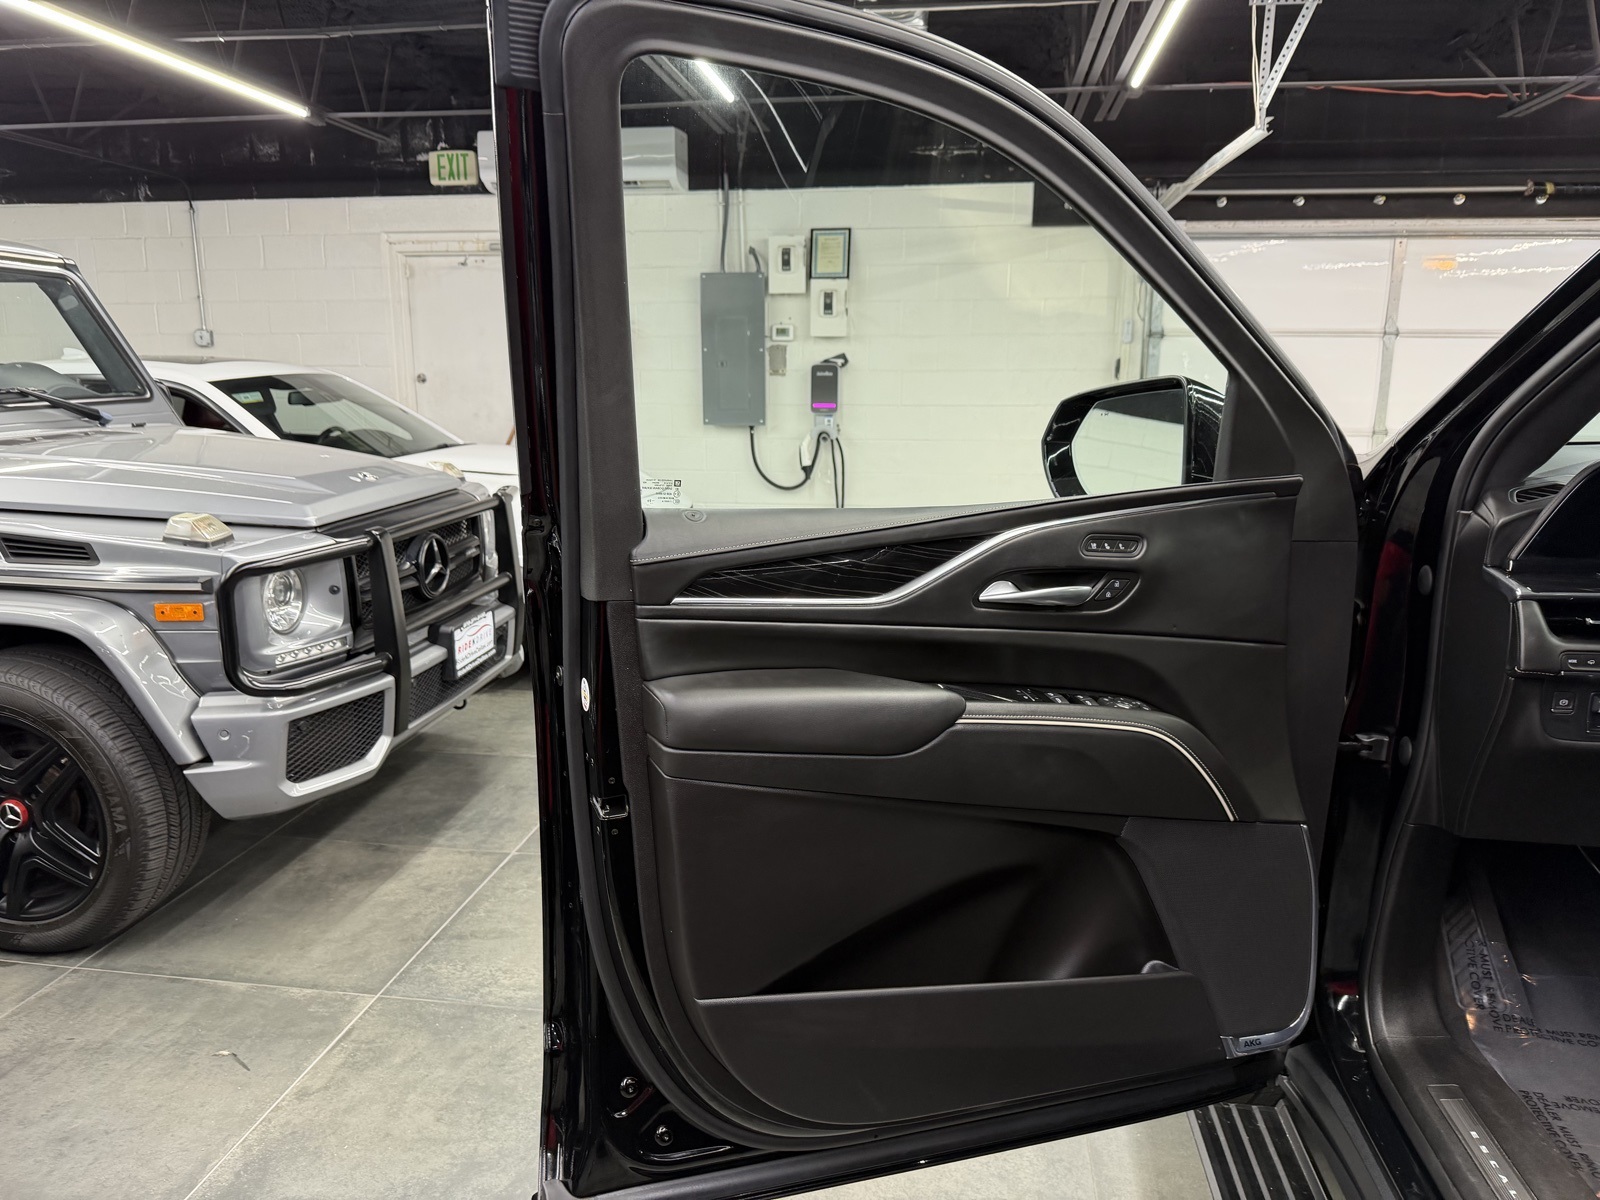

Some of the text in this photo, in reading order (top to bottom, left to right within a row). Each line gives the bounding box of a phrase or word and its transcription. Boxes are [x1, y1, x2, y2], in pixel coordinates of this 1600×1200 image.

[437, 153, 468, 181] EXIT
[1243, 1038, 1262, 1048] AKG
[1533, 1091, 1562, 1122] DEALER
[1556, 1124, 1582, 1149] MUST
